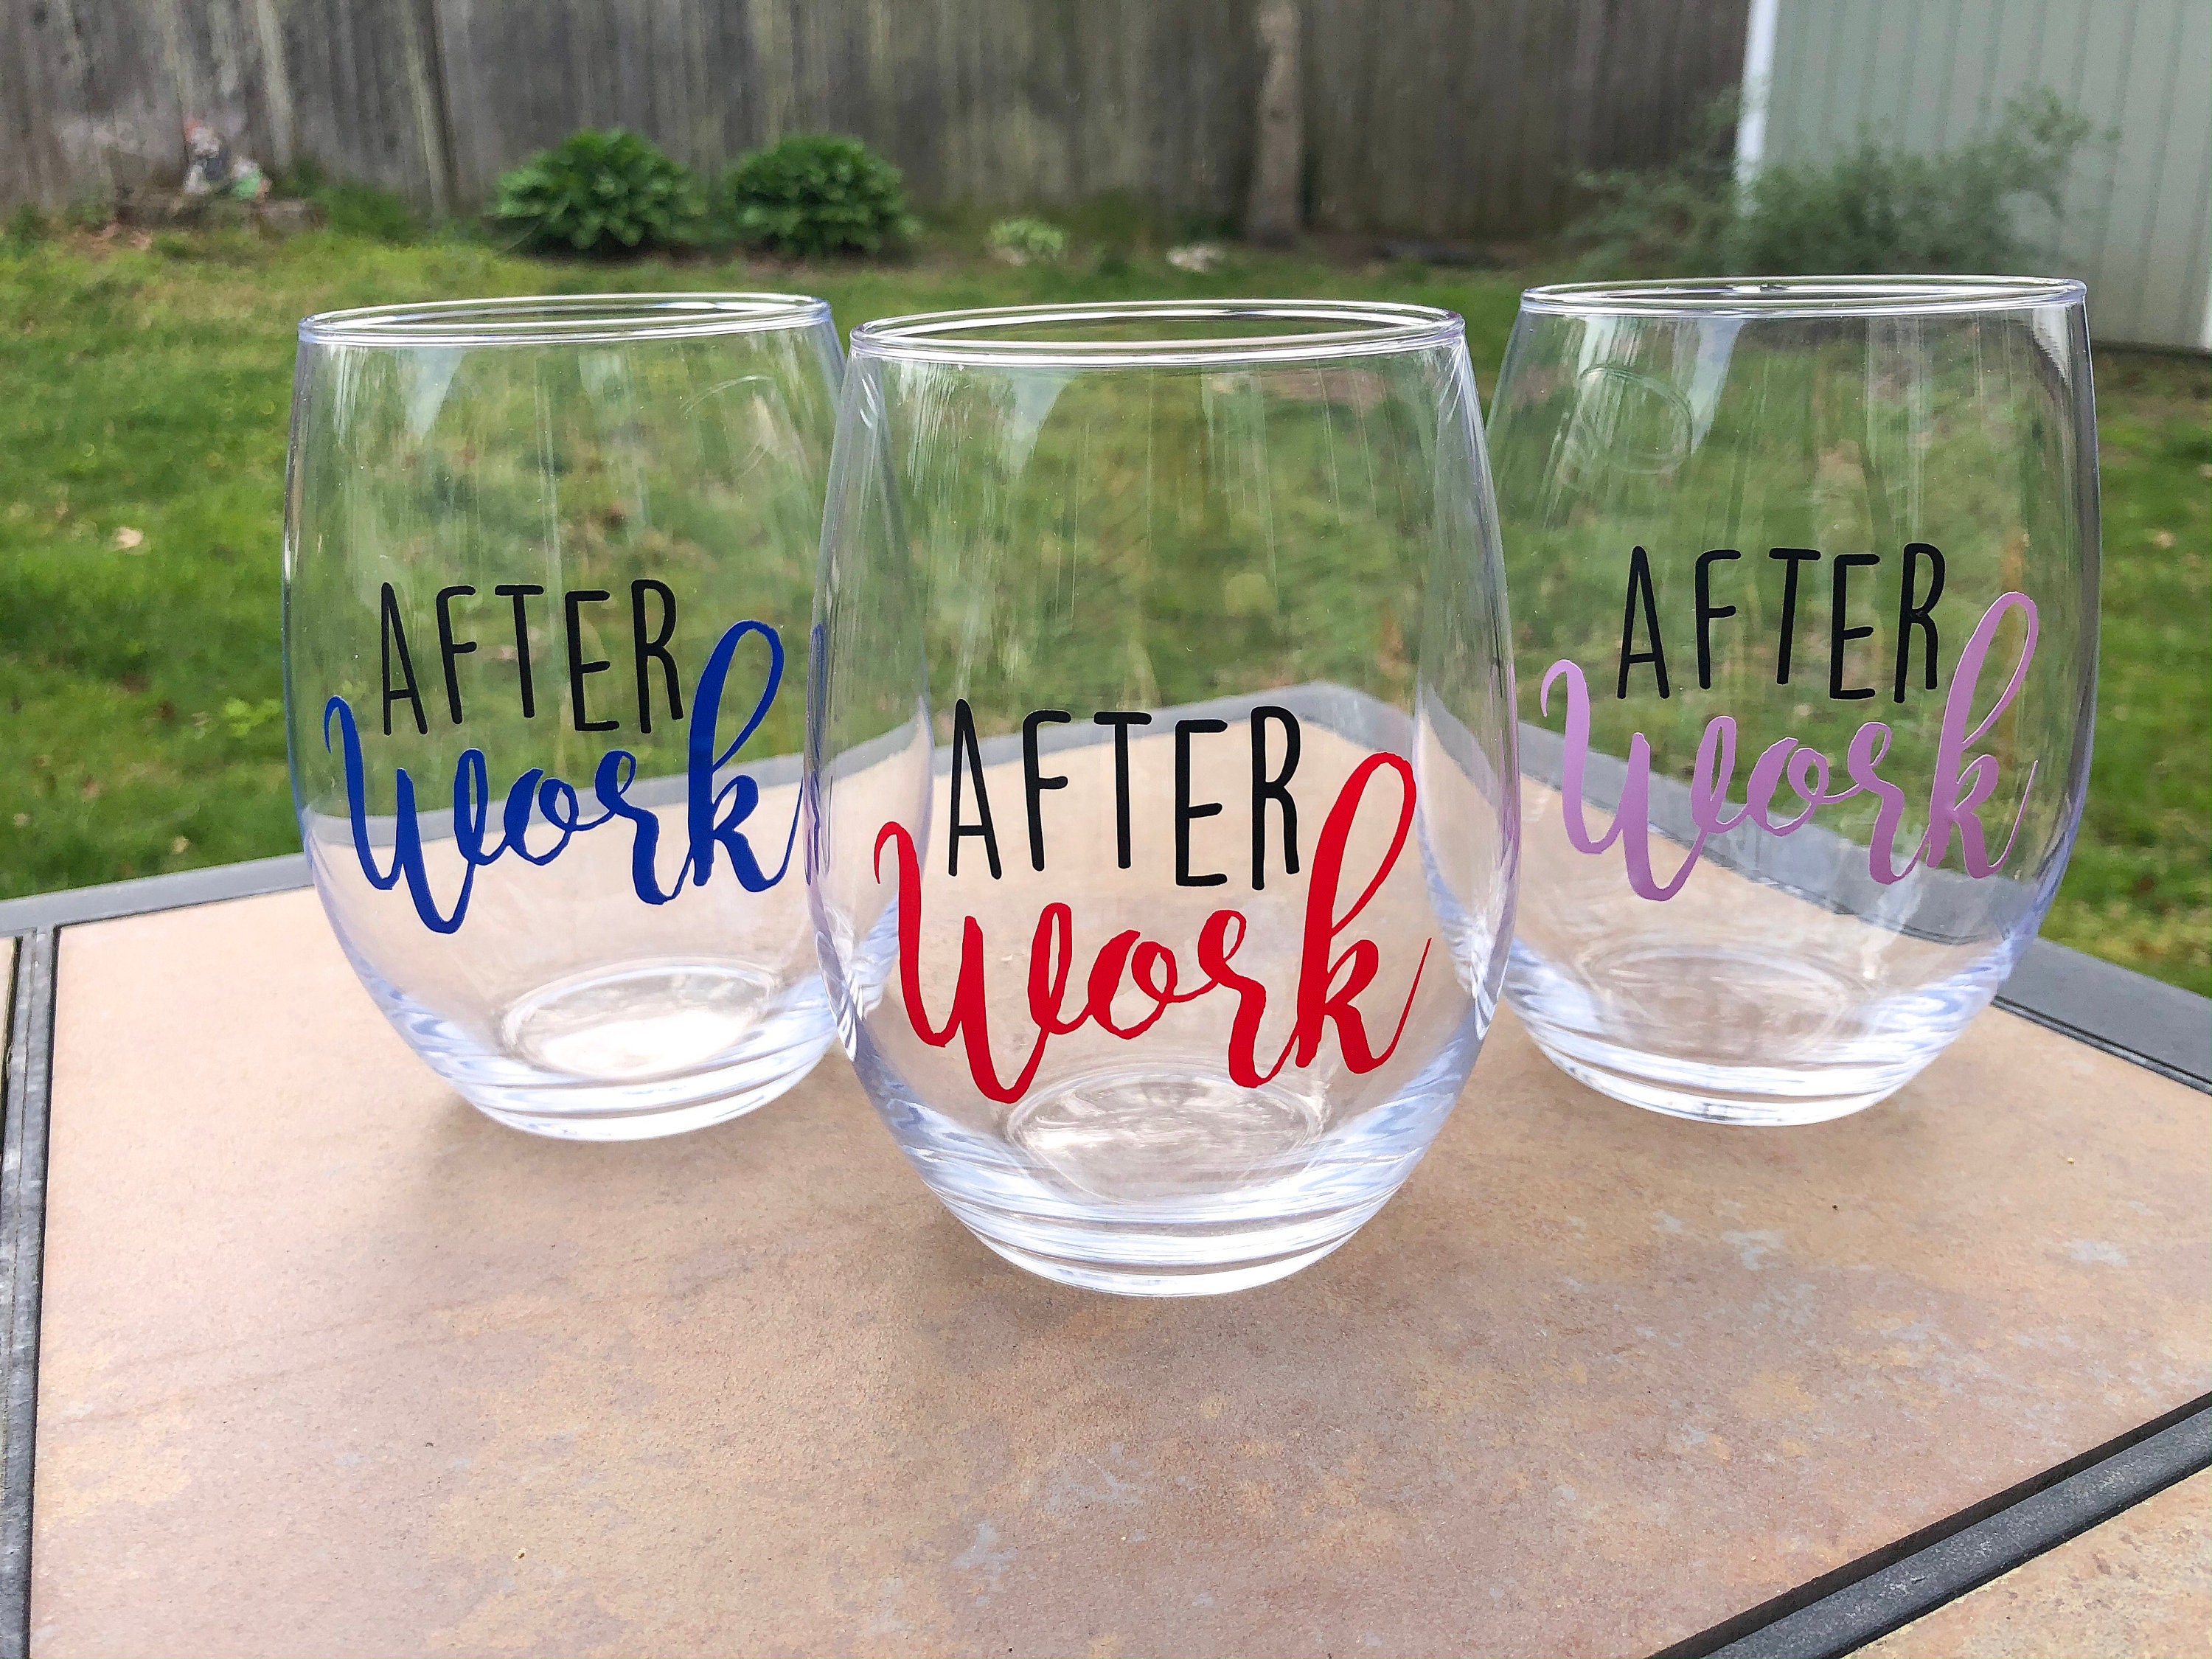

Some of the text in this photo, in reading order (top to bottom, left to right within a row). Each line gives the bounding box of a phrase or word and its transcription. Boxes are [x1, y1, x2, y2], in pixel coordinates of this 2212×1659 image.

[380, 579, 684, 735] AFTER
[1617, 543, 1946, 704] AFTER
[948, 698, 1301, 891] AFTER
